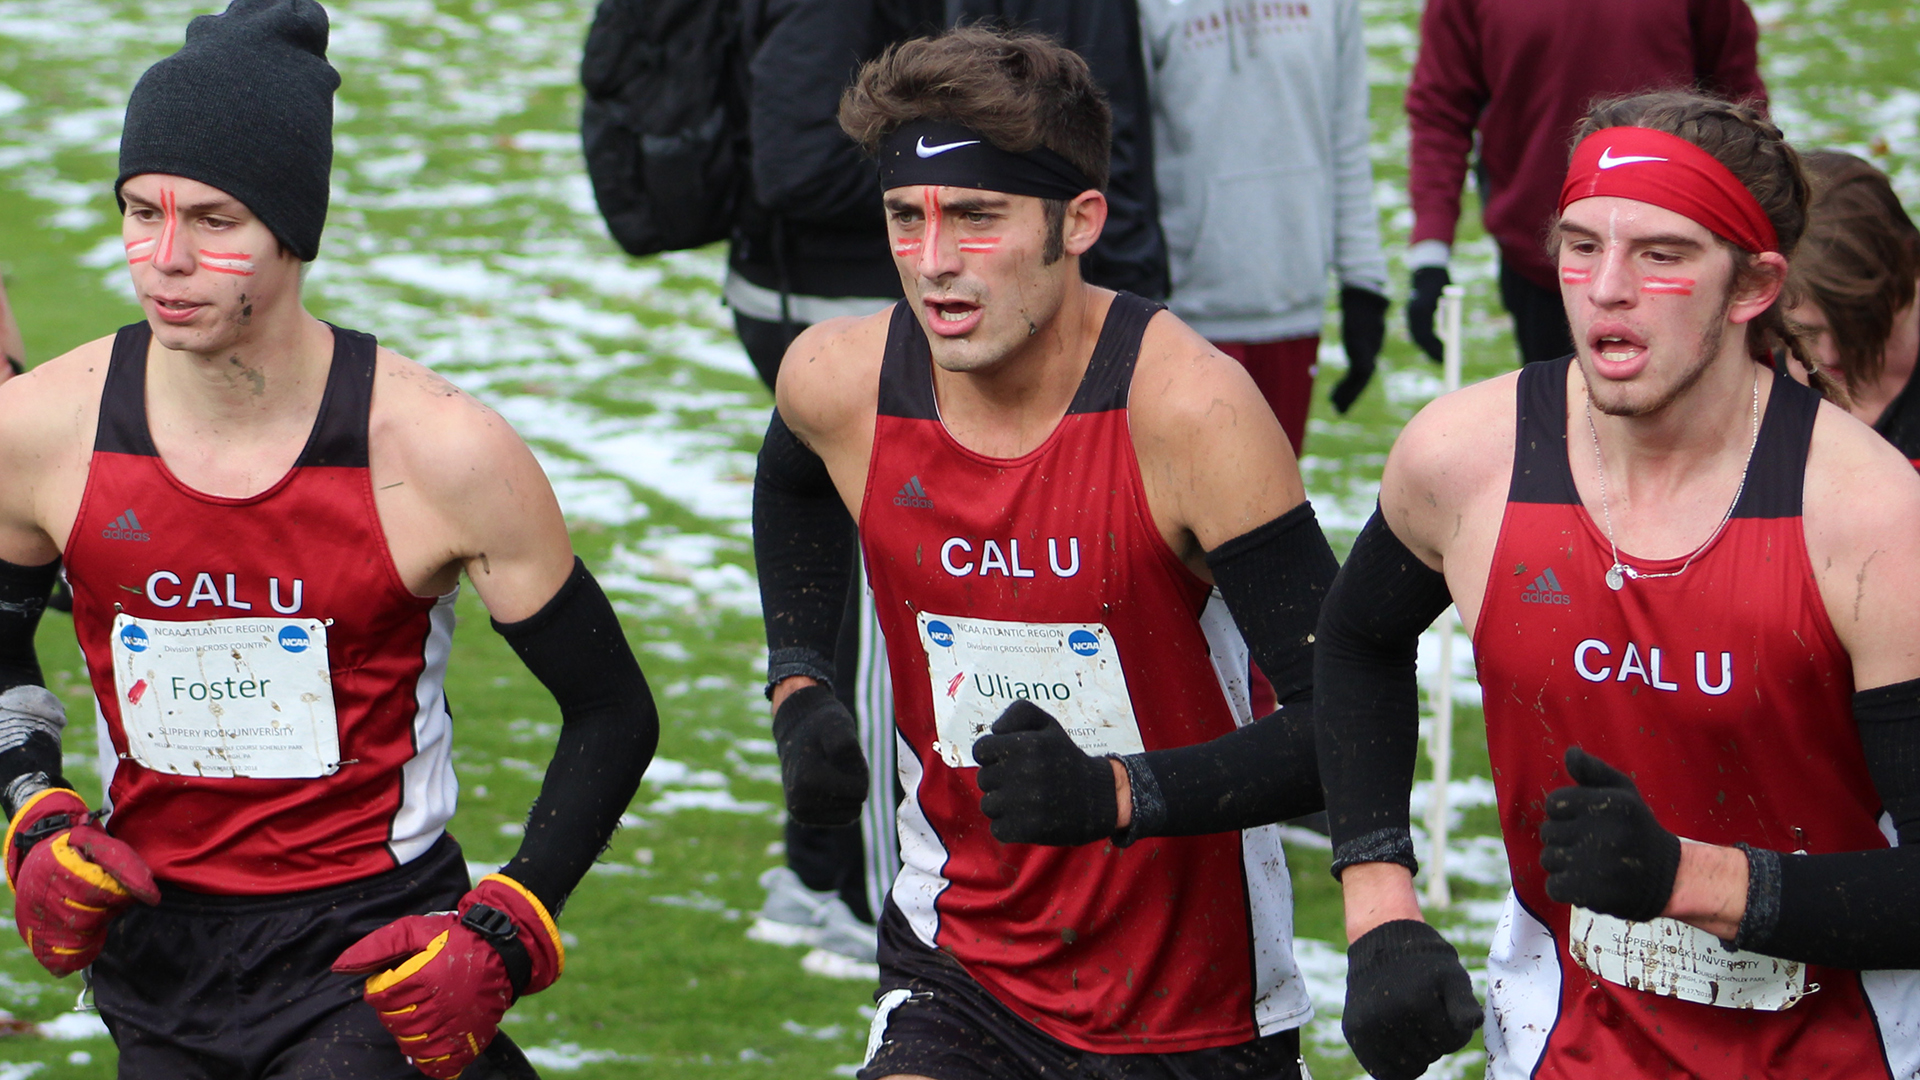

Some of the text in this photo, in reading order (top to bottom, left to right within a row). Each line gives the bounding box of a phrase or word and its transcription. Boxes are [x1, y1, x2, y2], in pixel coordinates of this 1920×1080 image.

[893, 496, 934, 509] adidas
[102, 528, 150, 542] adidas
[940, 537, 1081, 578] CAL U
[145, 570, 304, 614] CAL U
[1520, 590, 1571, 605] adidas
[154, 624, 275, 637] NCAA ATLANTIC REGION
[957, 623, 1064, 638] NCAA ATLANTIC REGION
[123, 635, 150, 647] NCAA
[164, 645, 194, 653] Division
[203, 643, 229, 652] CROSS
[230, 641, 268, 650] COUNTRY
[282, 637, 310, 648] NCAA
[966, 642, 993, 652] Division
[1000, 645, 1023, 653] CROSS
[1072, 641, 1100, 651] NCAA
[1573, 638, 1733, 696] CAL U
[171, 676, 272, 701] Foster
[974, 673, 1071, 701] Uliano
[159, 727, 295, 738] SLIPPERY ROCK UNIVERISITY
